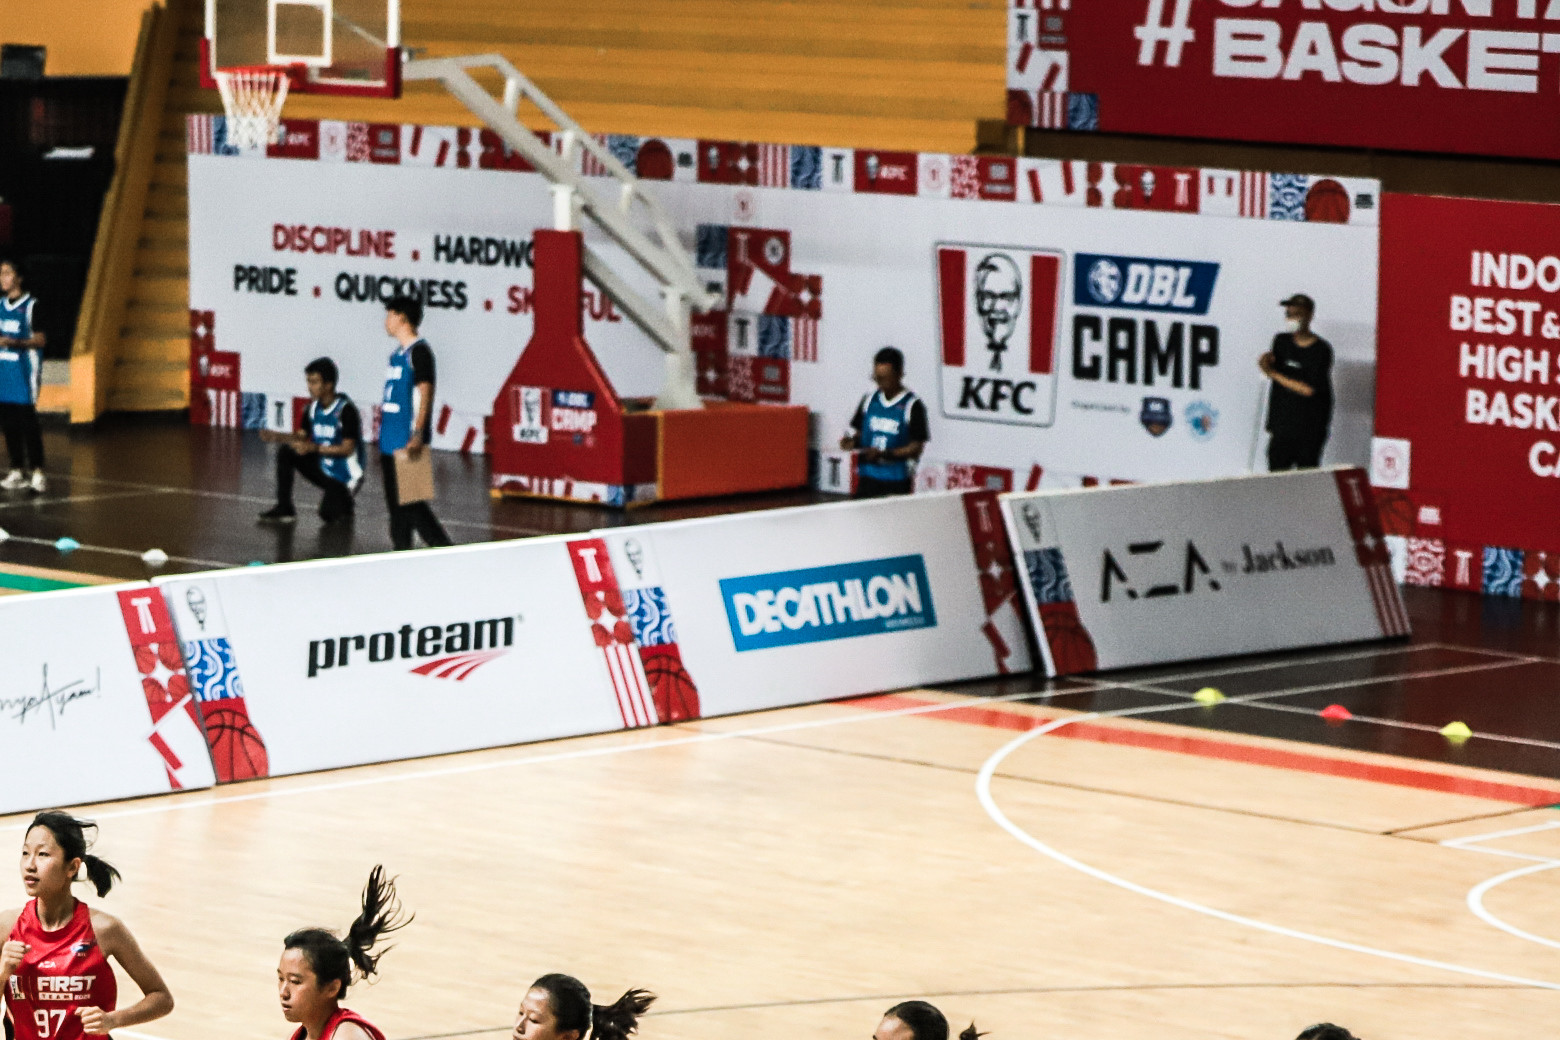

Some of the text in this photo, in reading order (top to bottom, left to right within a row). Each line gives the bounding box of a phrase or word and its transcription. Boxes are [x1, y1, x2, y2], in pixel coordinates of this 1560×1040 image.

[272, 223, 397, 259] DISCIPLINE
[234, 265, 298, 296] PRIDE
[335, 272, 468, 310] QUICKNESS
[1123, 262, 1197, 308] DBL
[1072, 314, 1219, 390] CAMP
[1459, 342, 1550, 385] HIGH
[959, 376, 1037, 415] KFC
[1466, 388, 1560, 432] BASK
[1241, 540, 1336, 575] Jackson
[733, 571, 923, 636] DECATHLON
[307, 616, 514, 678] proteam
[37, 975, 96, 992] FIRST
[34, 1009, 67, 1038] 97
